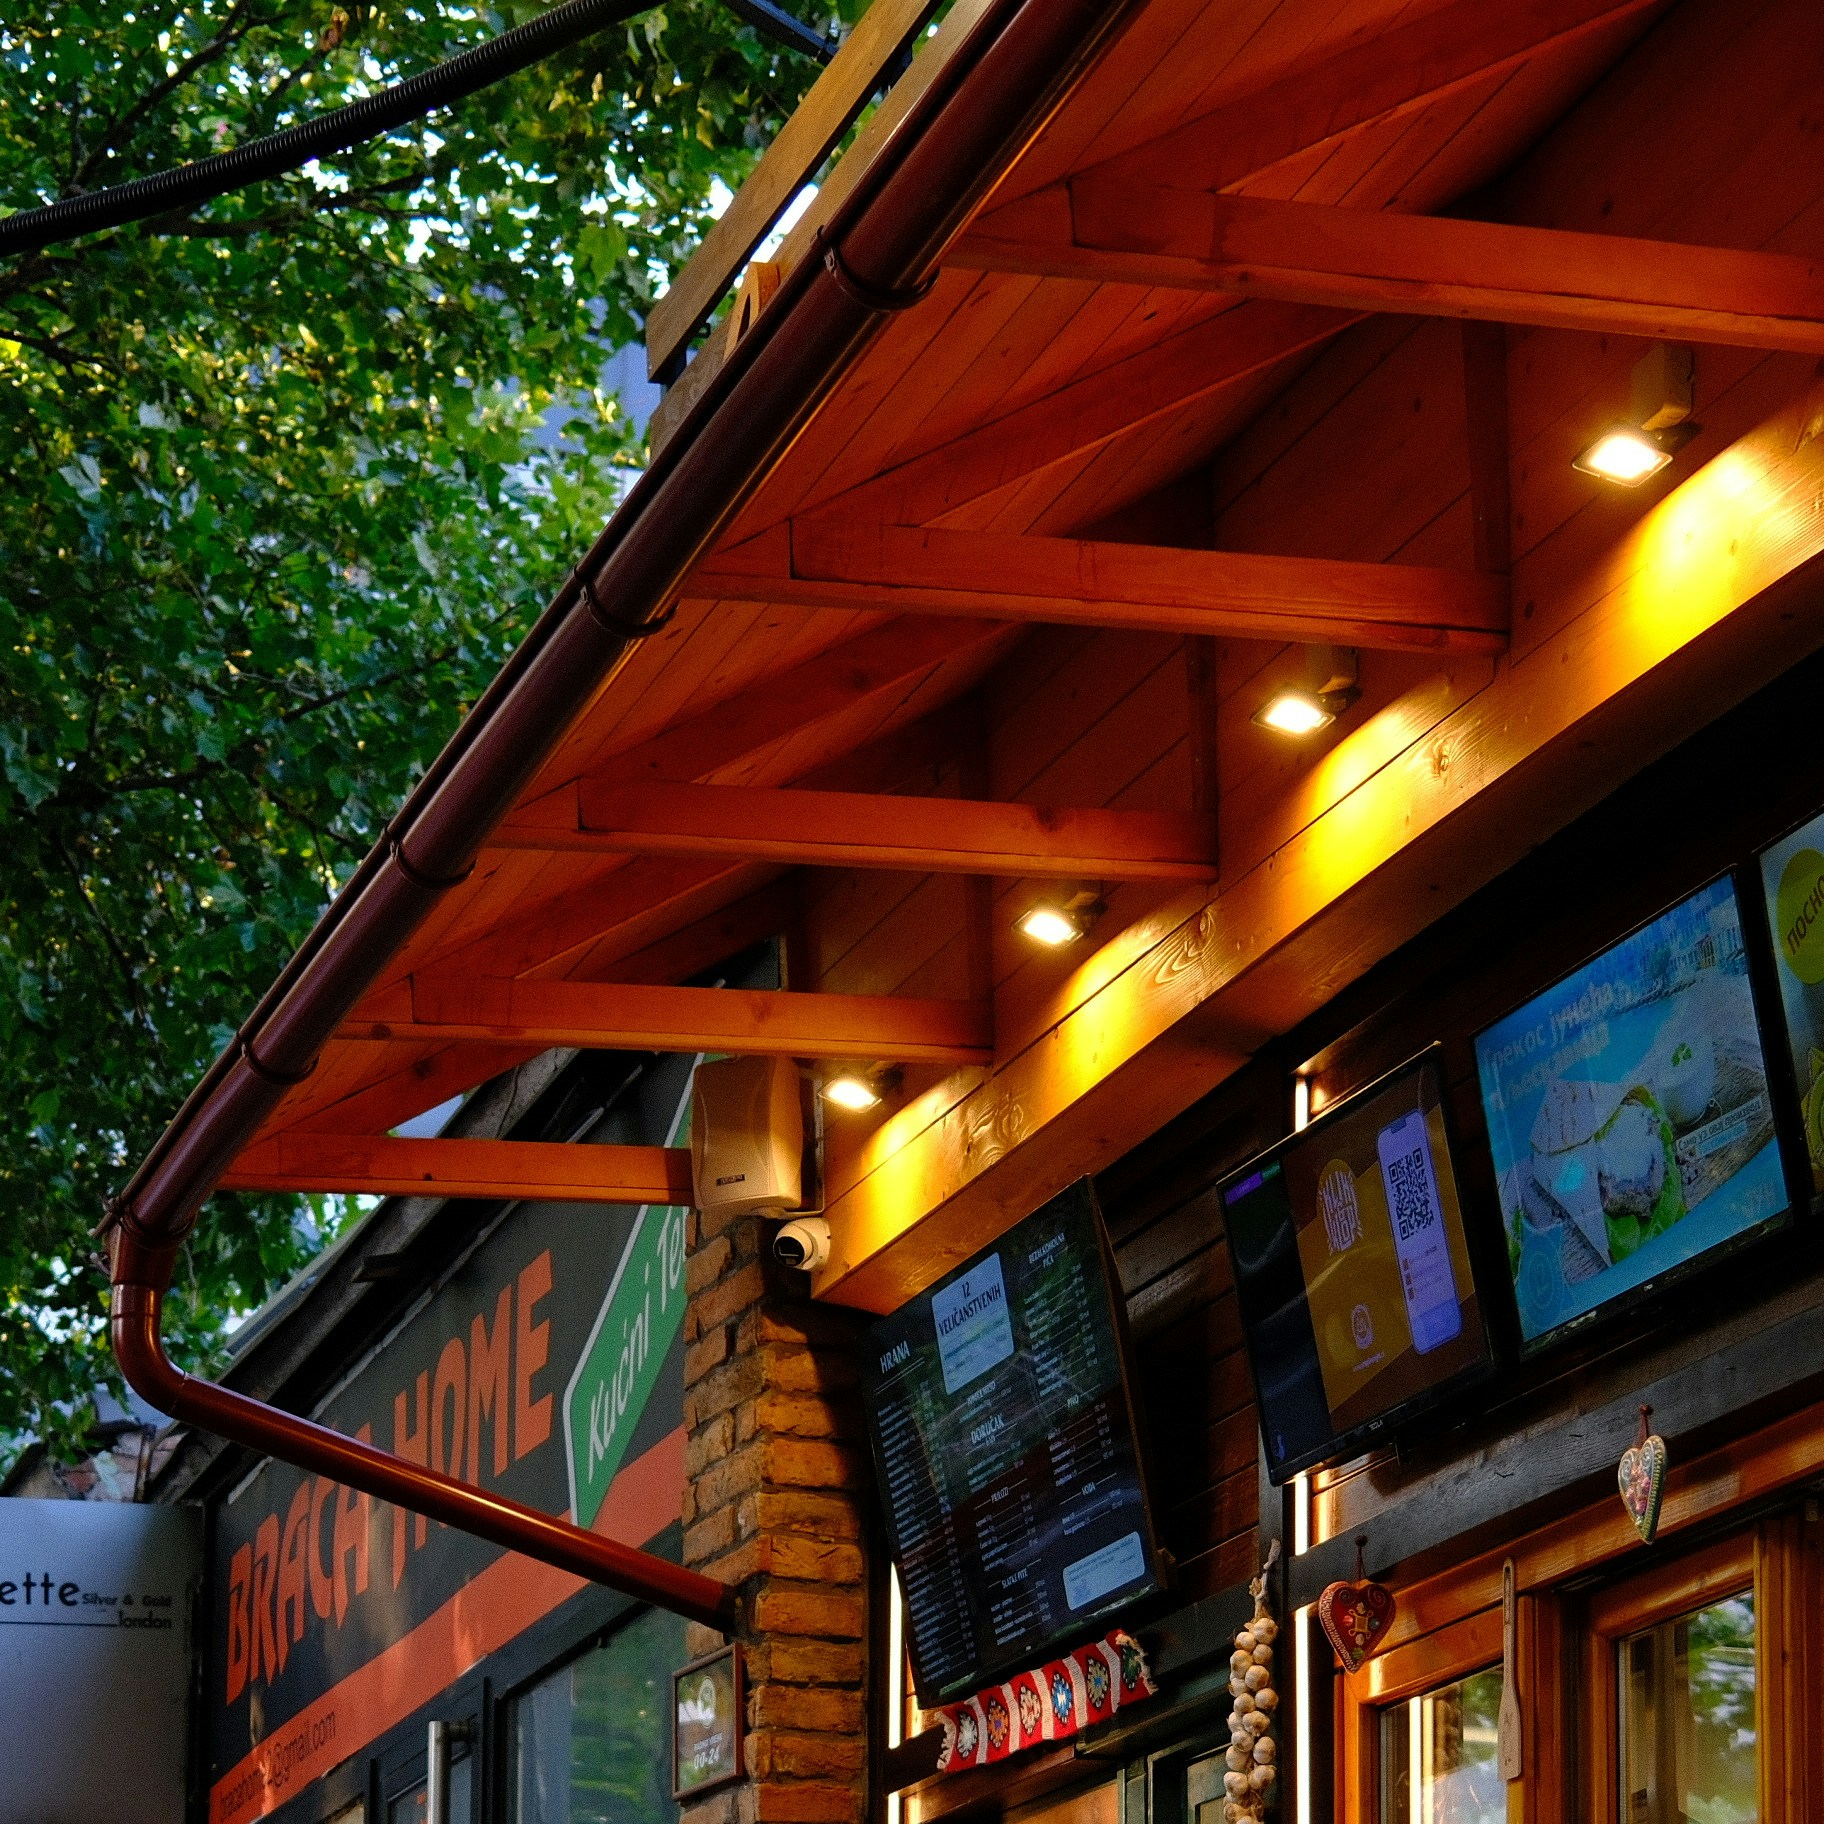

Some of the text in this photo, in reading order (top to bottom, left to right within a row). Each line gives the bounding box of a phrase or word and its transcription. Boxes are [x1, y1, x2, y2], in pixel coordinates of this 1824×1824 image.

[962, 1280, 970, 1298] 12
[939, 1286, 1002, 1338] VELIČANSTVENIH
[588, 1261, 650, 1484] Kućni
[880, 1339, 909, 1373] HRANA
[392, 1248, 555, 1591] HOME
[82, 1593, 118, 1607] Silver
[693, 1746, 720, 1770] 00-24
